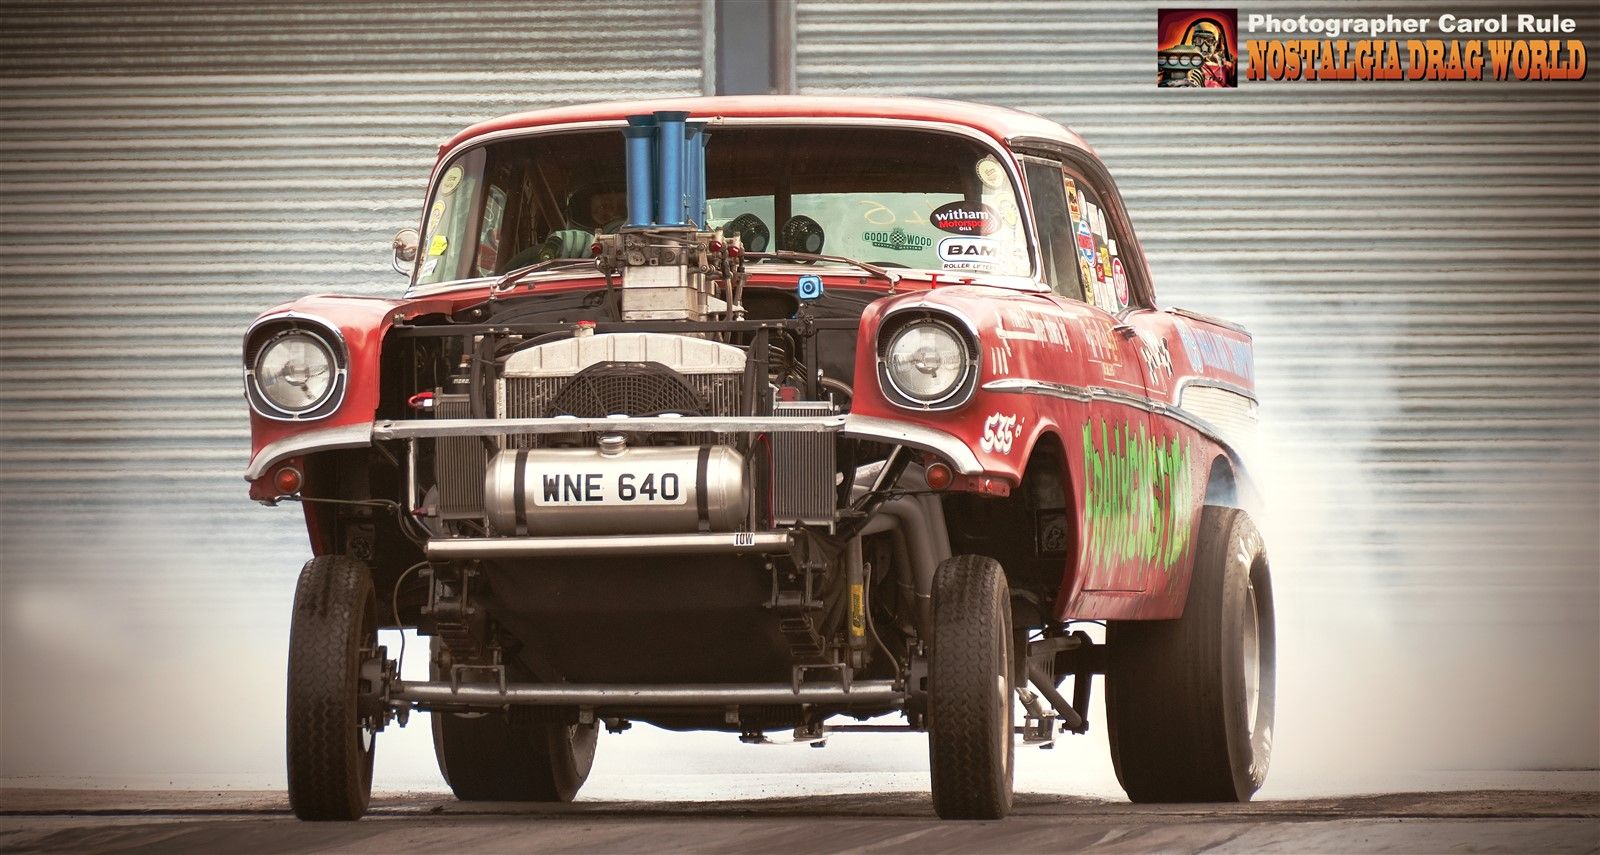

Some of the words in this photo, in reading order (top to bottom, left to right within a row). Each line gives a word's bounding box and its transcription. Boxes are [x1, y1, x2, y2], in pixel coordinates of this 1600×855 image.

[935, 208, 989, 221] witham
[938, 219, 989, 229] Motorspo
[979, 411, 1017, 455] 535
[542, 473, 604, 502] WNE
[617, 473, 680, 501] 640
